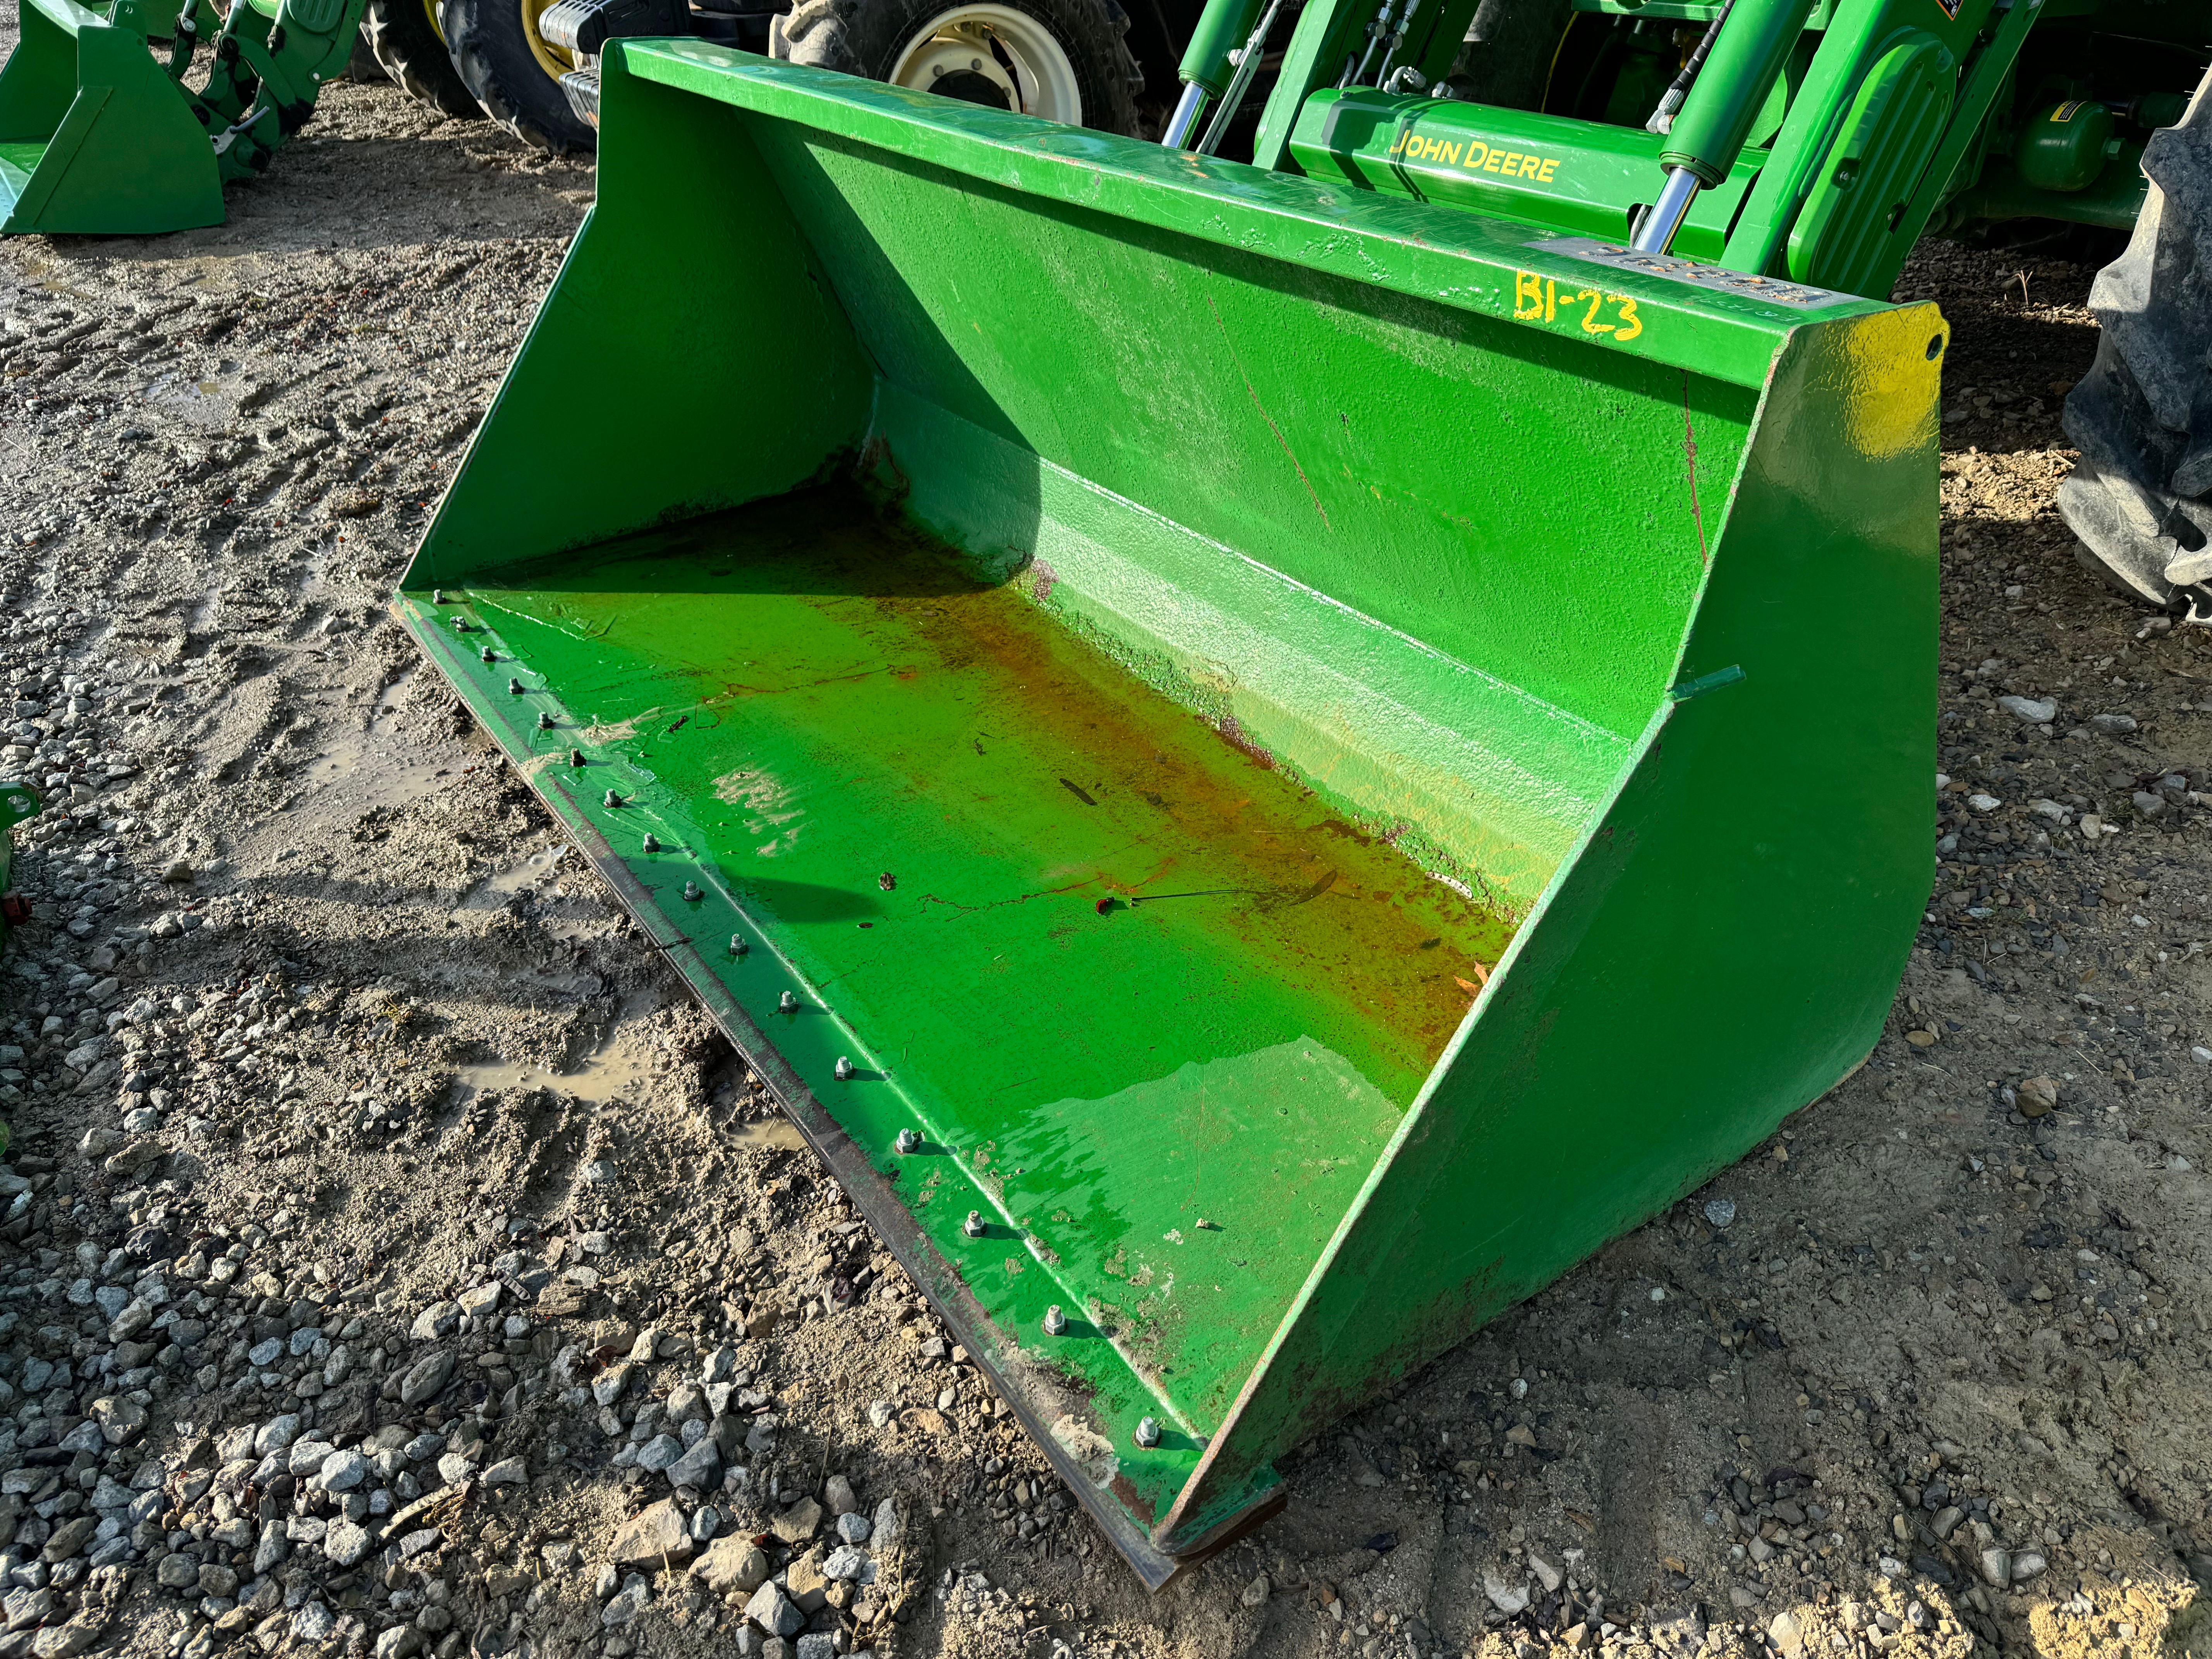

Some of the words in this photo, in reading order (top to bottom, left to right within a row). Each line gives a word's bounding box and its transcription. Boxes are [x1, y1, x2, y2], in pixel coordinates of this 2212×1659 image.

[1389, 129, 1462, 164] JOHN
[1463, 141, 1561, 183] DEERE
[1513, 270, 1642, 341] B1-23
